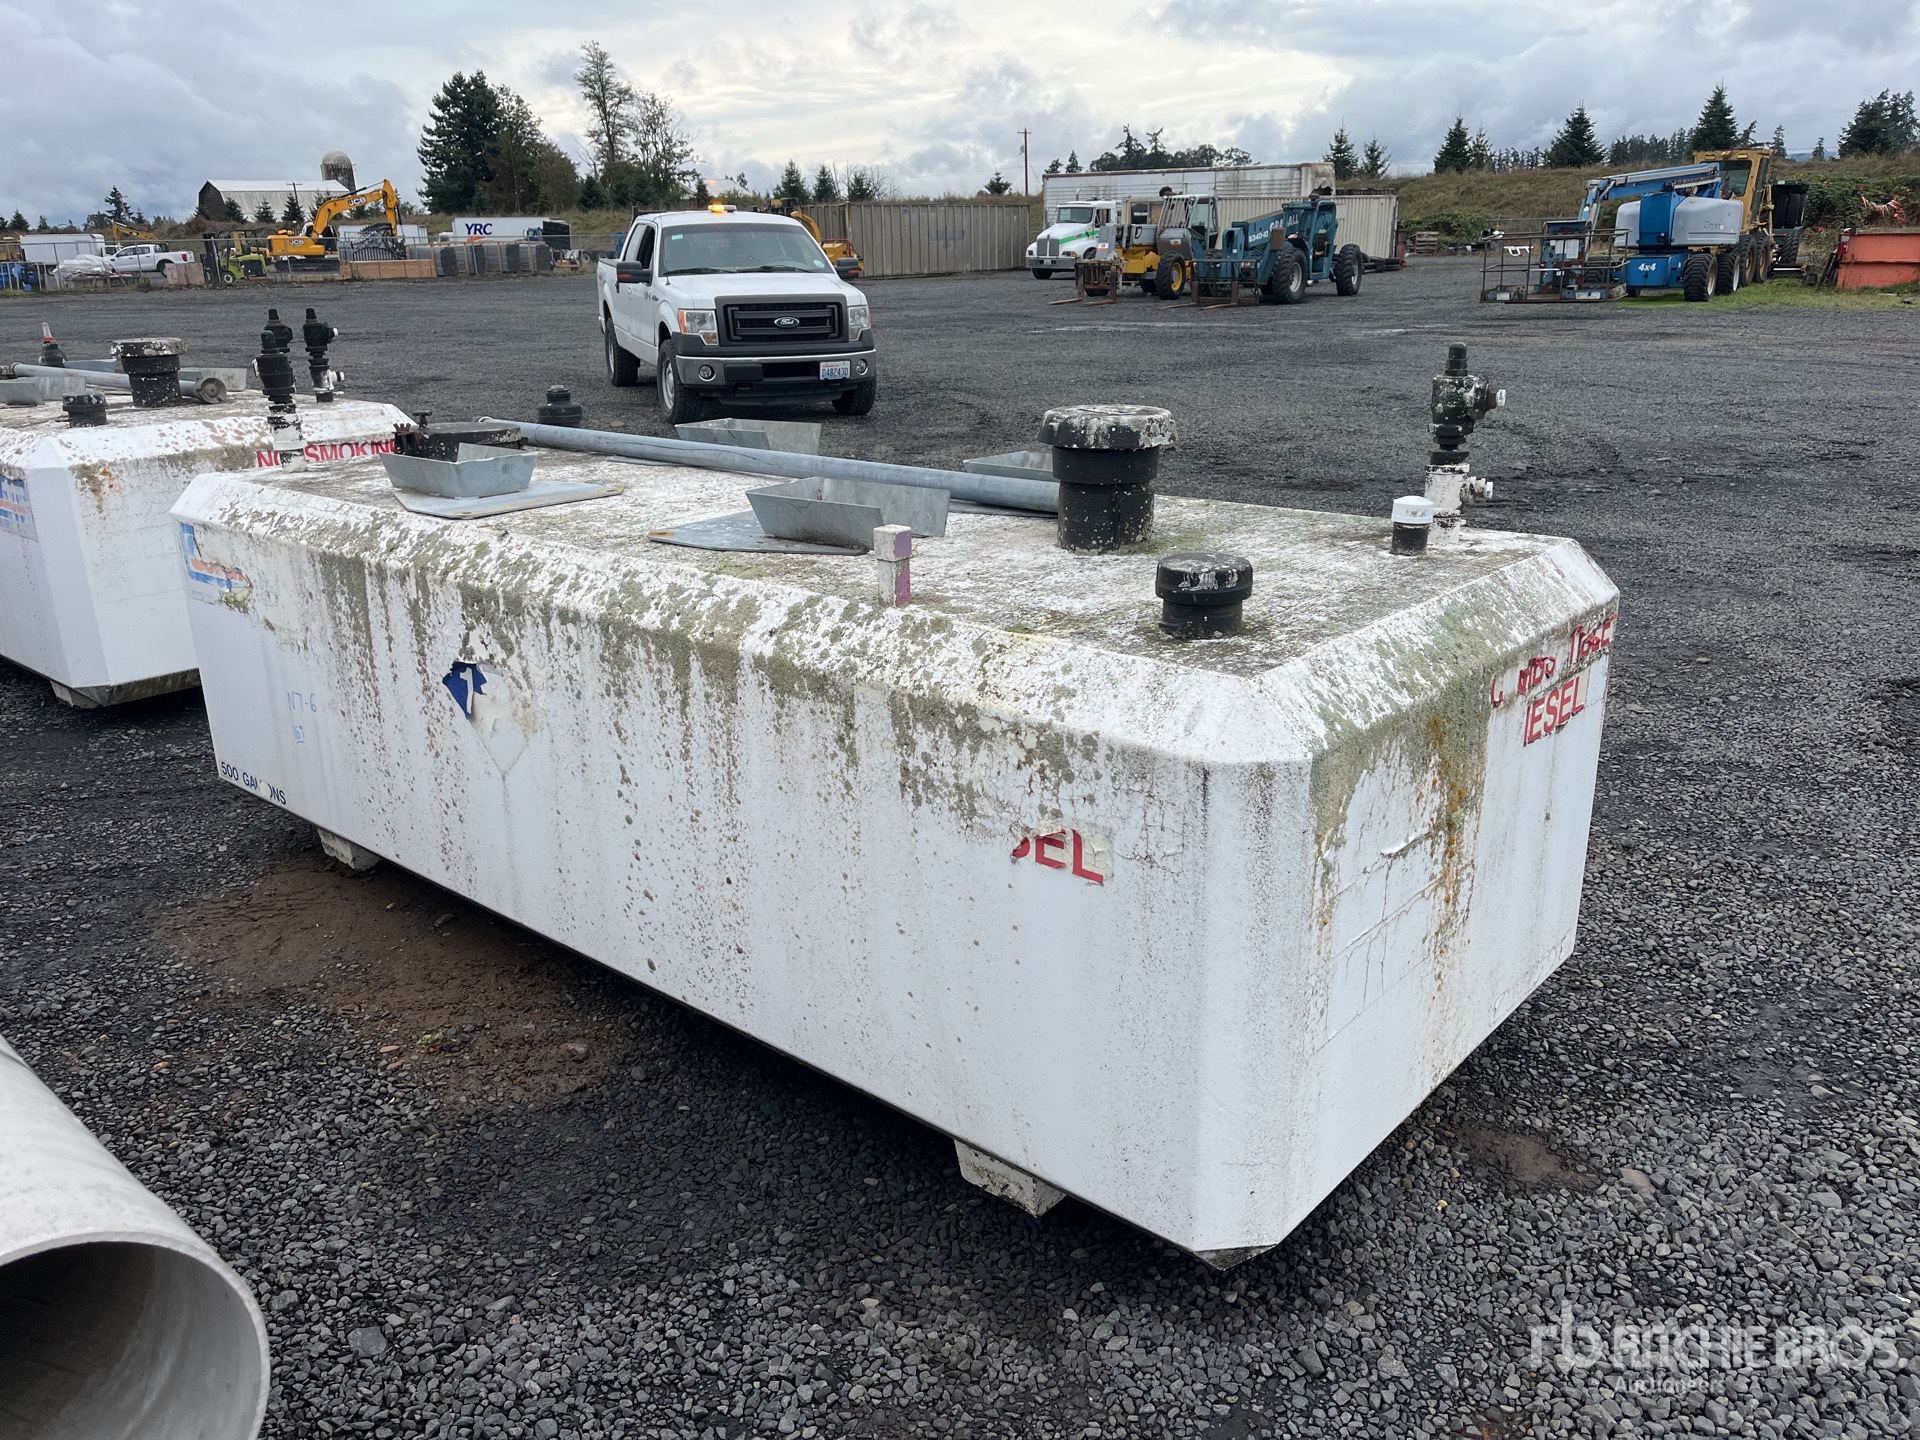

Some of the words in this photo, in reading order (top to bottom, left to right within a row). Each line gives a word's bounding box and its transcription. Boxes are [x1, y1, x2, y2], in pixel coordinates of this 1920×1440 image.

[348, 198, 367, 206] JCB
[465, 223, 492, 235] YRC
[1638, 262, 1657, 272] 4x4
[221, 761, 238, 780] 500
